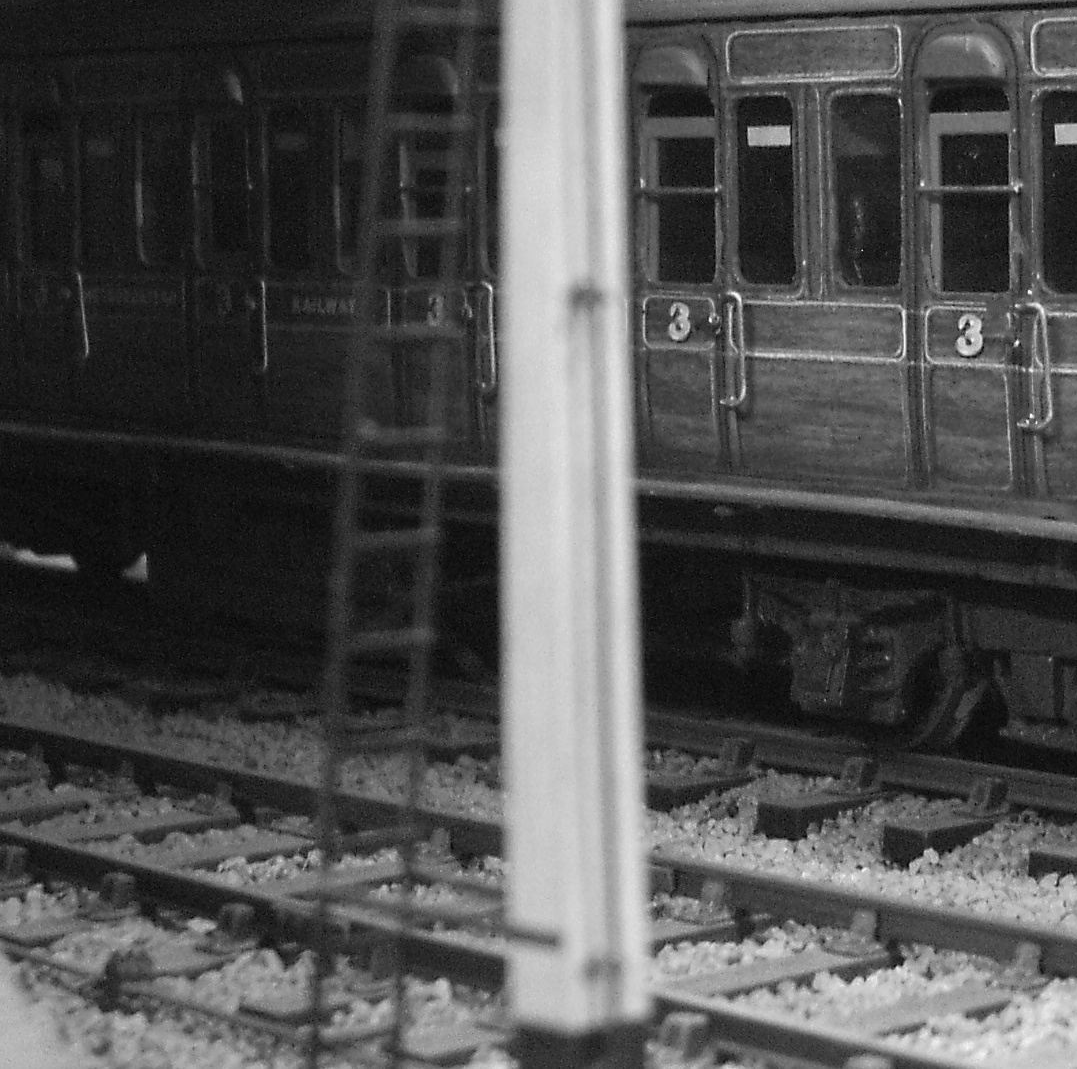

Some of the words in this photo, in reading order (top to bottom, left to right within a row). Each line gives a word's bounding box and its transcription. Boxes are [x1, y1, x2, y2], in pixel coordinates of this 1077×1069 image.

[427, 293, 445, 328] 3
[668, 303, 691, 341] 3
[956, 313, 984, 357] 3
